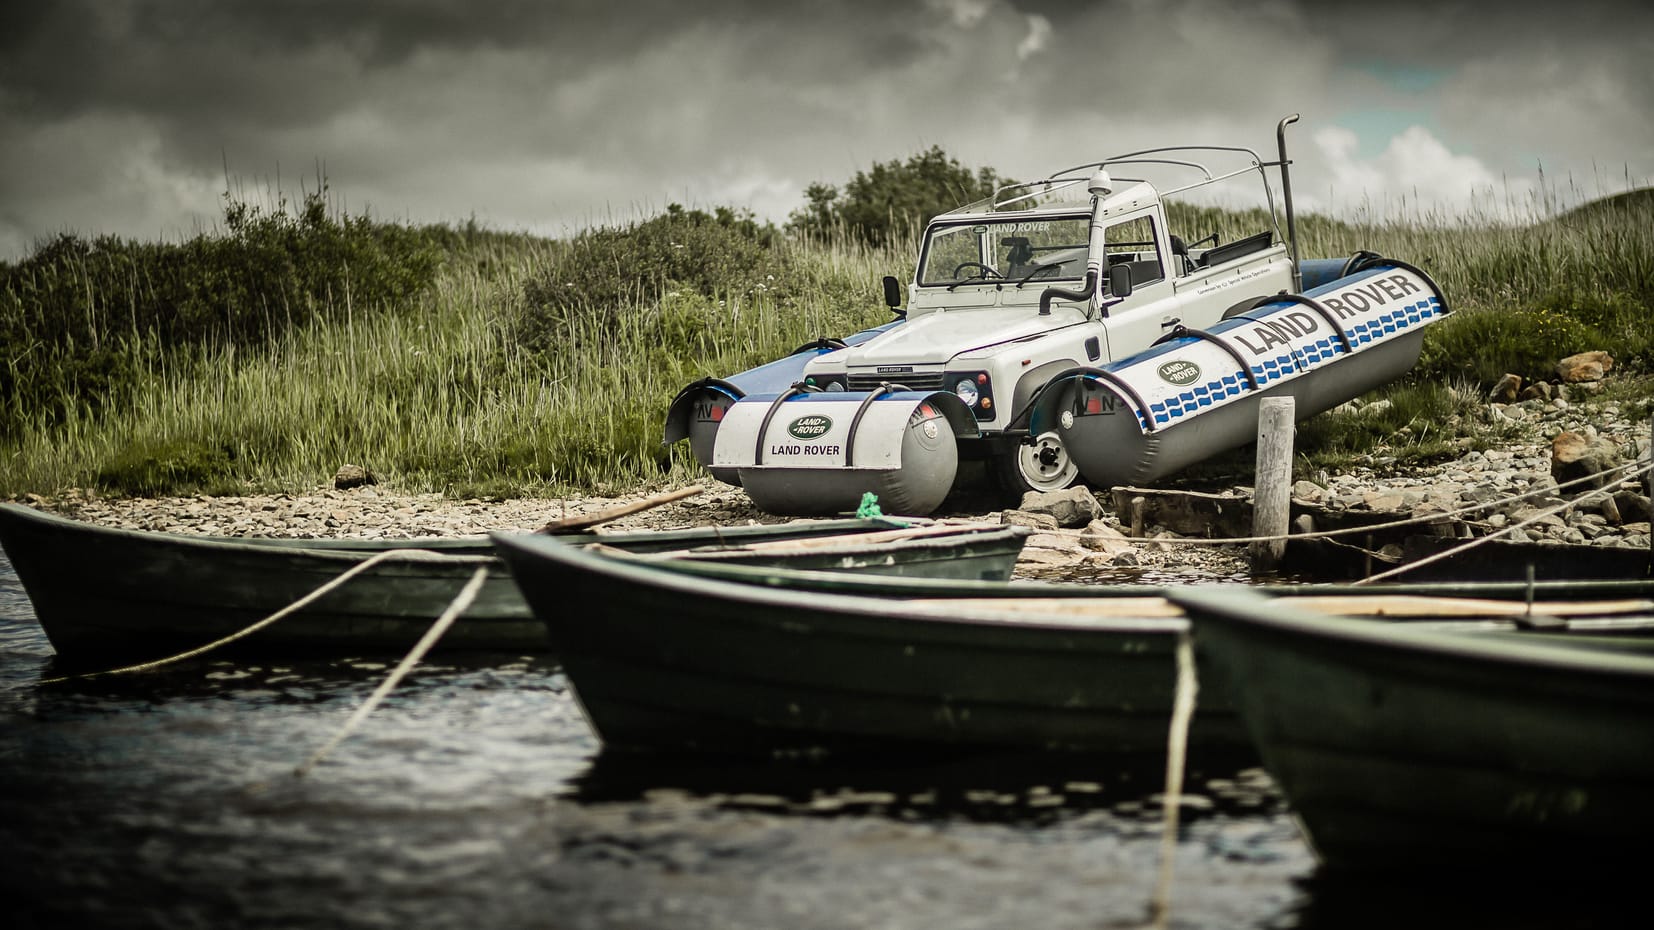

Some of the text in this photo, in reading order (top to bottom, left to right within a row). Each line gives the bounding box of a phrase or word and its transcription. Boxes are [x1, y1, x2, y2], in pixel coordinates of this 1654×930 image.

[989, 224, 1016, 233] LAND
[1017, 222, 1050, 232] ROVER
[1234, 274, 1421, 356] LAND ROVER
[1161, 363, 1184, 376] LAND
[1171, 366, 1198, 382] ROVER
[797, 418, 822, 426] LAND
[796, 425, 826, 434] ROVER
[772, 445, 840, 455] LAND ROVER
